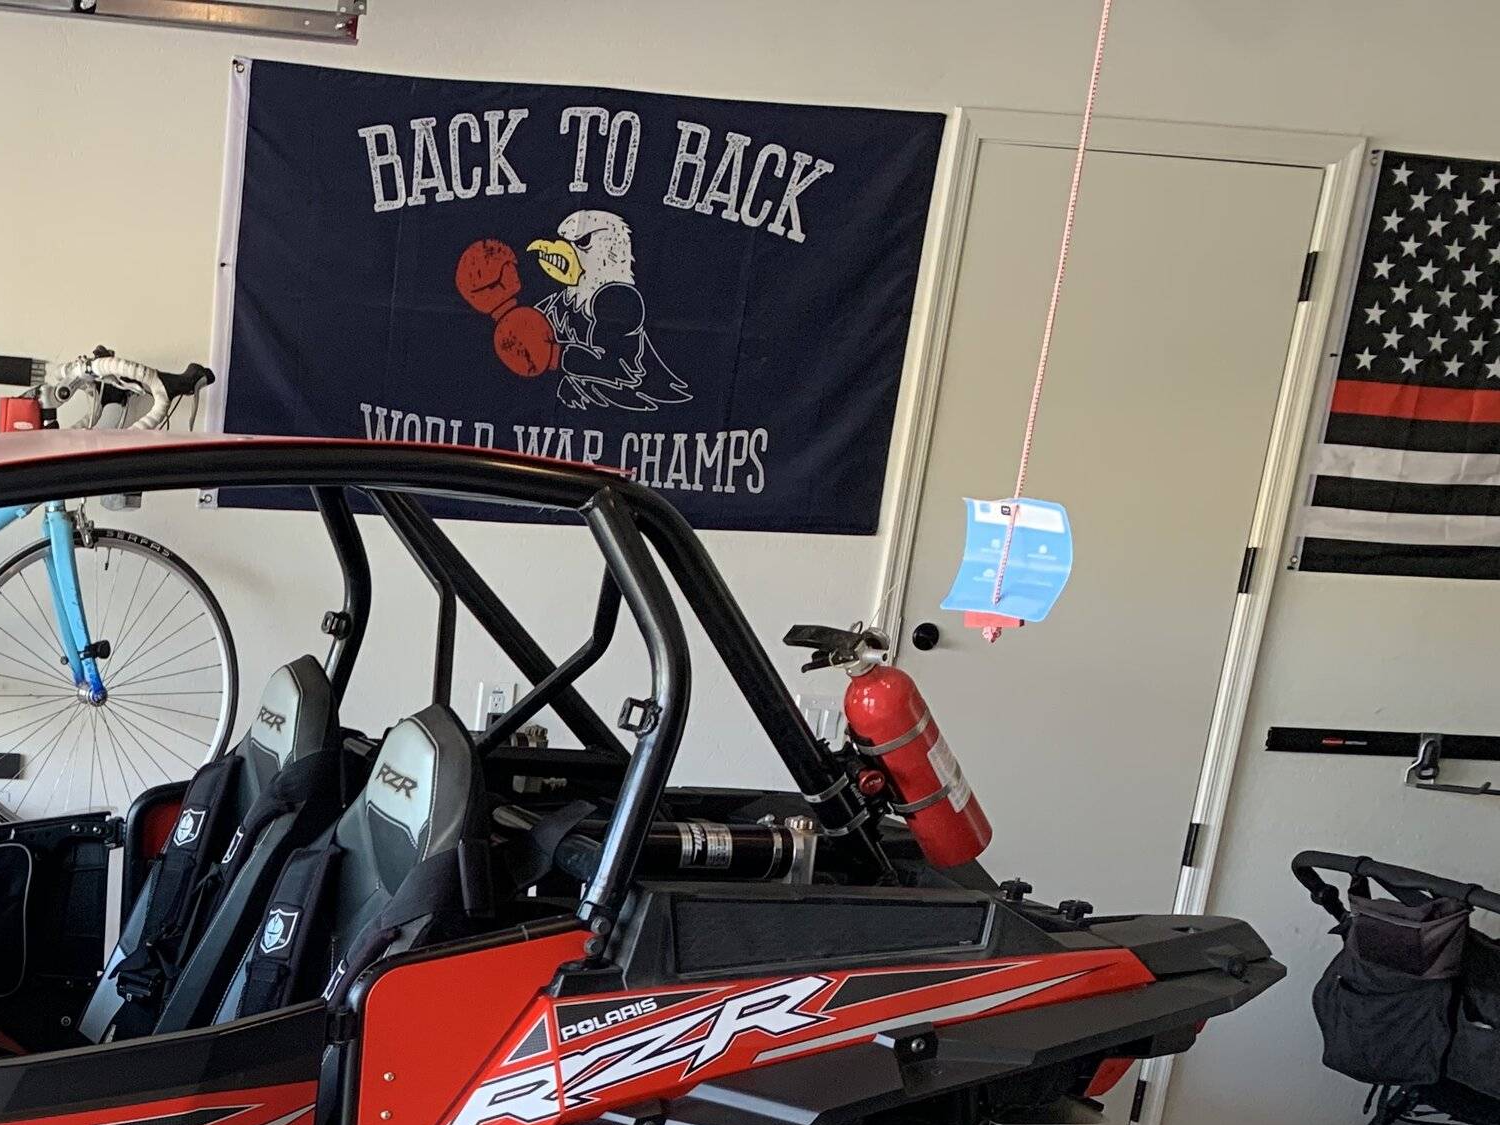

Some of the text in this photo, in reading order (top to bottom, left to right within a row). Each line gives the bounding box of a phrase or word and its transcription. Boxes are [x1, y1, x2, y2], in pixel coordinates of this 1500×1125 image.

[358, 106, 835, 243] BACK TO BACK
[620, 428, 768, 494] CHAMPS
[257, 706, 287, 732] RZR
[375, 763, 418, 798] RZR
[562, 998, 658, 1041] POLARIS
